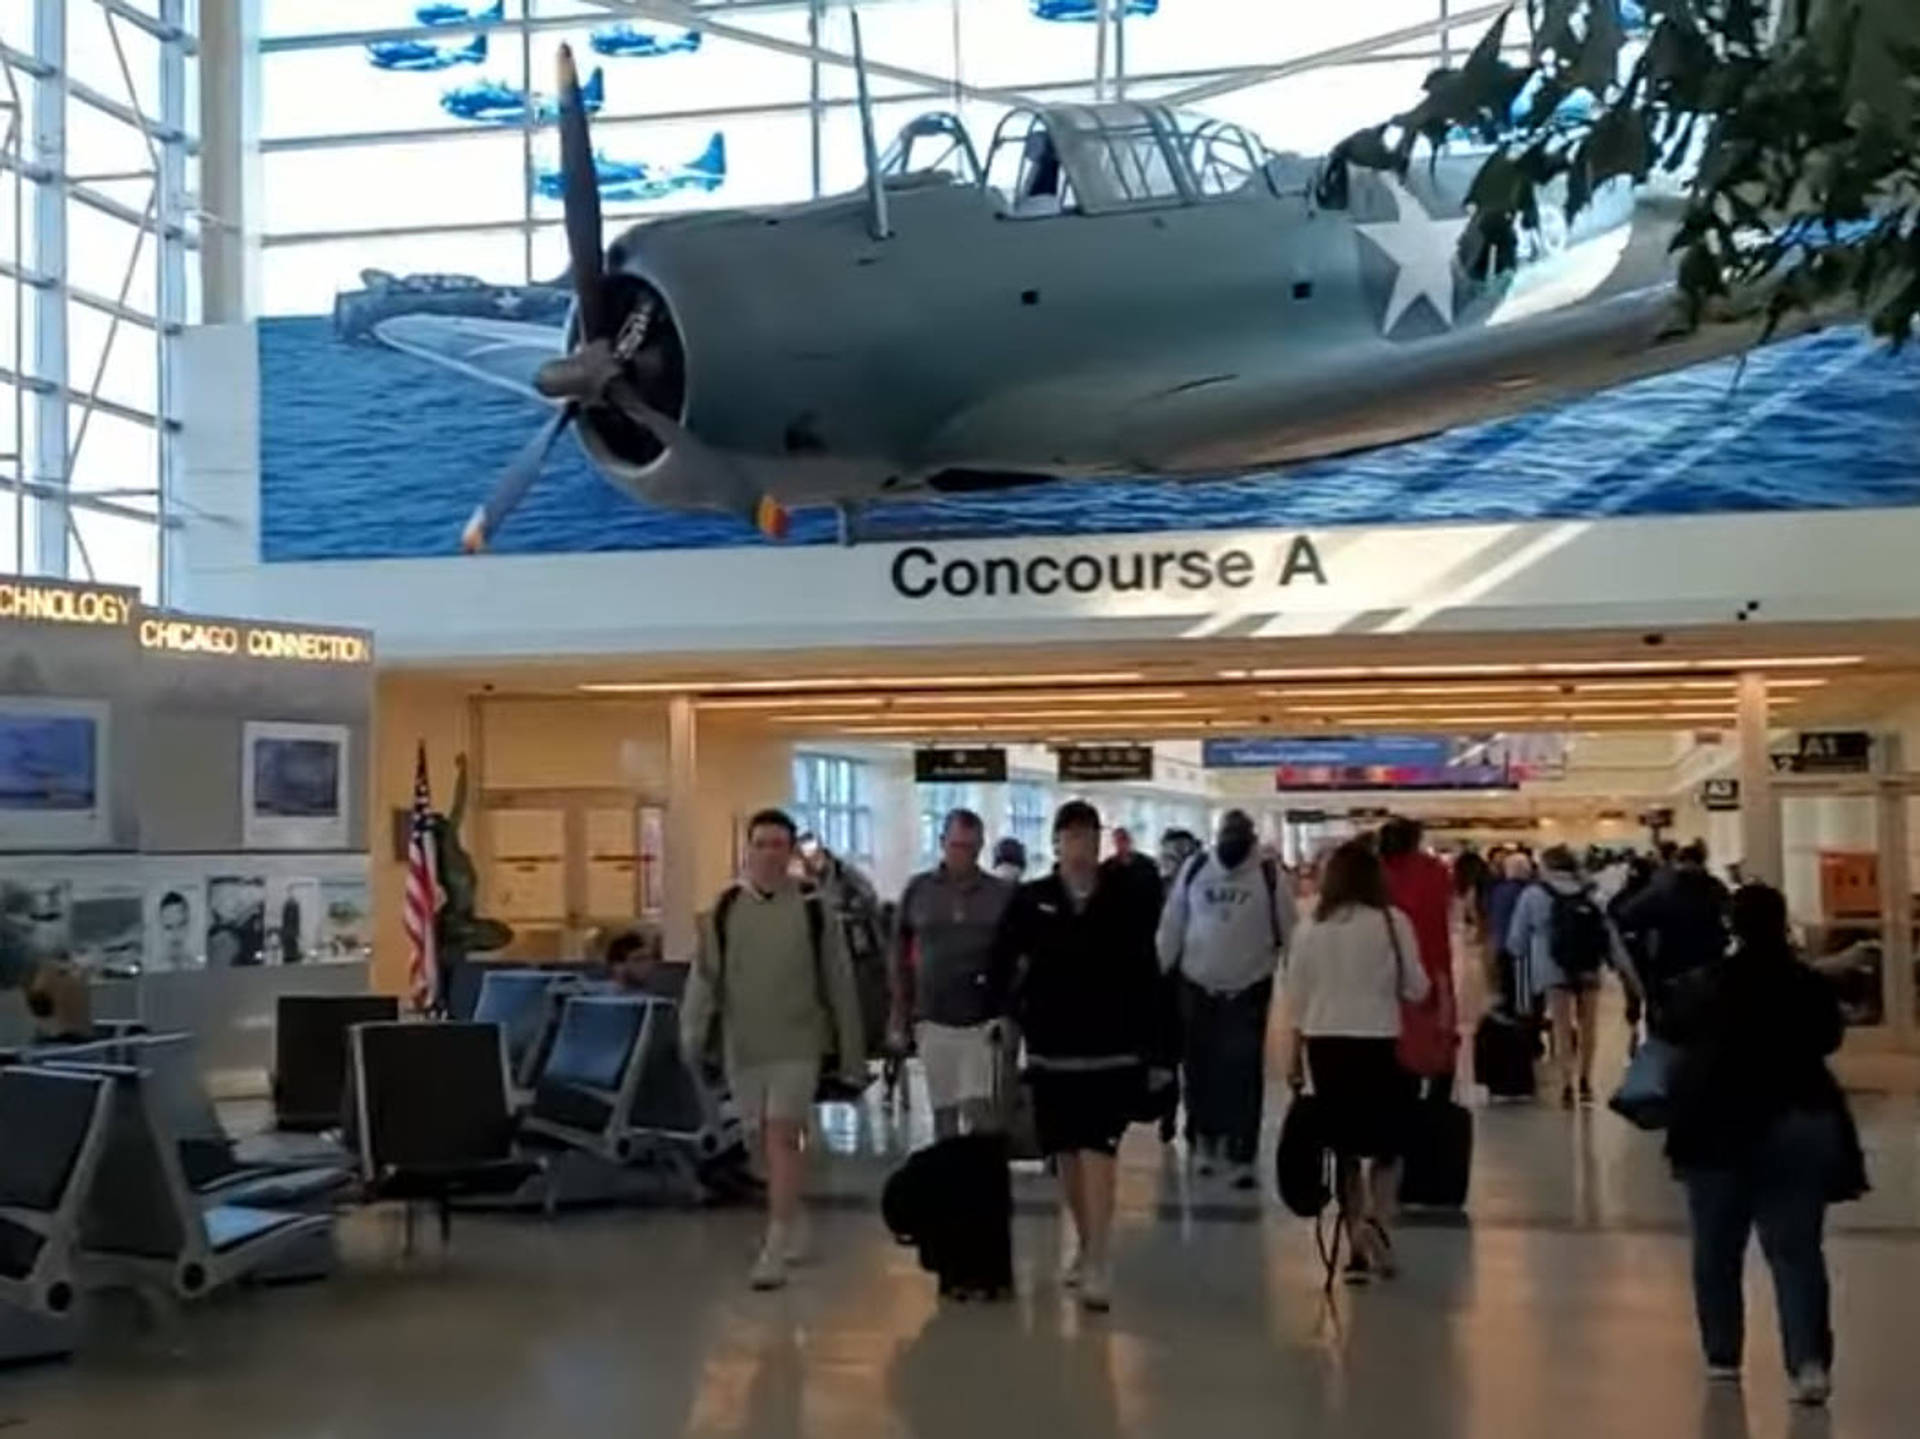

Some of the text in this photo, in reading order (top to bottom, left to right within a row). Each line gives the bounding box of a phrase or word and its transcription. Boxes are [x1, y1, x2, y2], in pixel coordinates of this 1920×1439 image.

[891, 535, 1328, 599] Concourse A
[0, 584, 130, 624] CHNOLOGY
[140, 619, 372, 662] CHICAGO CONNECTION
[1804, 736, 1837, 756] A1
